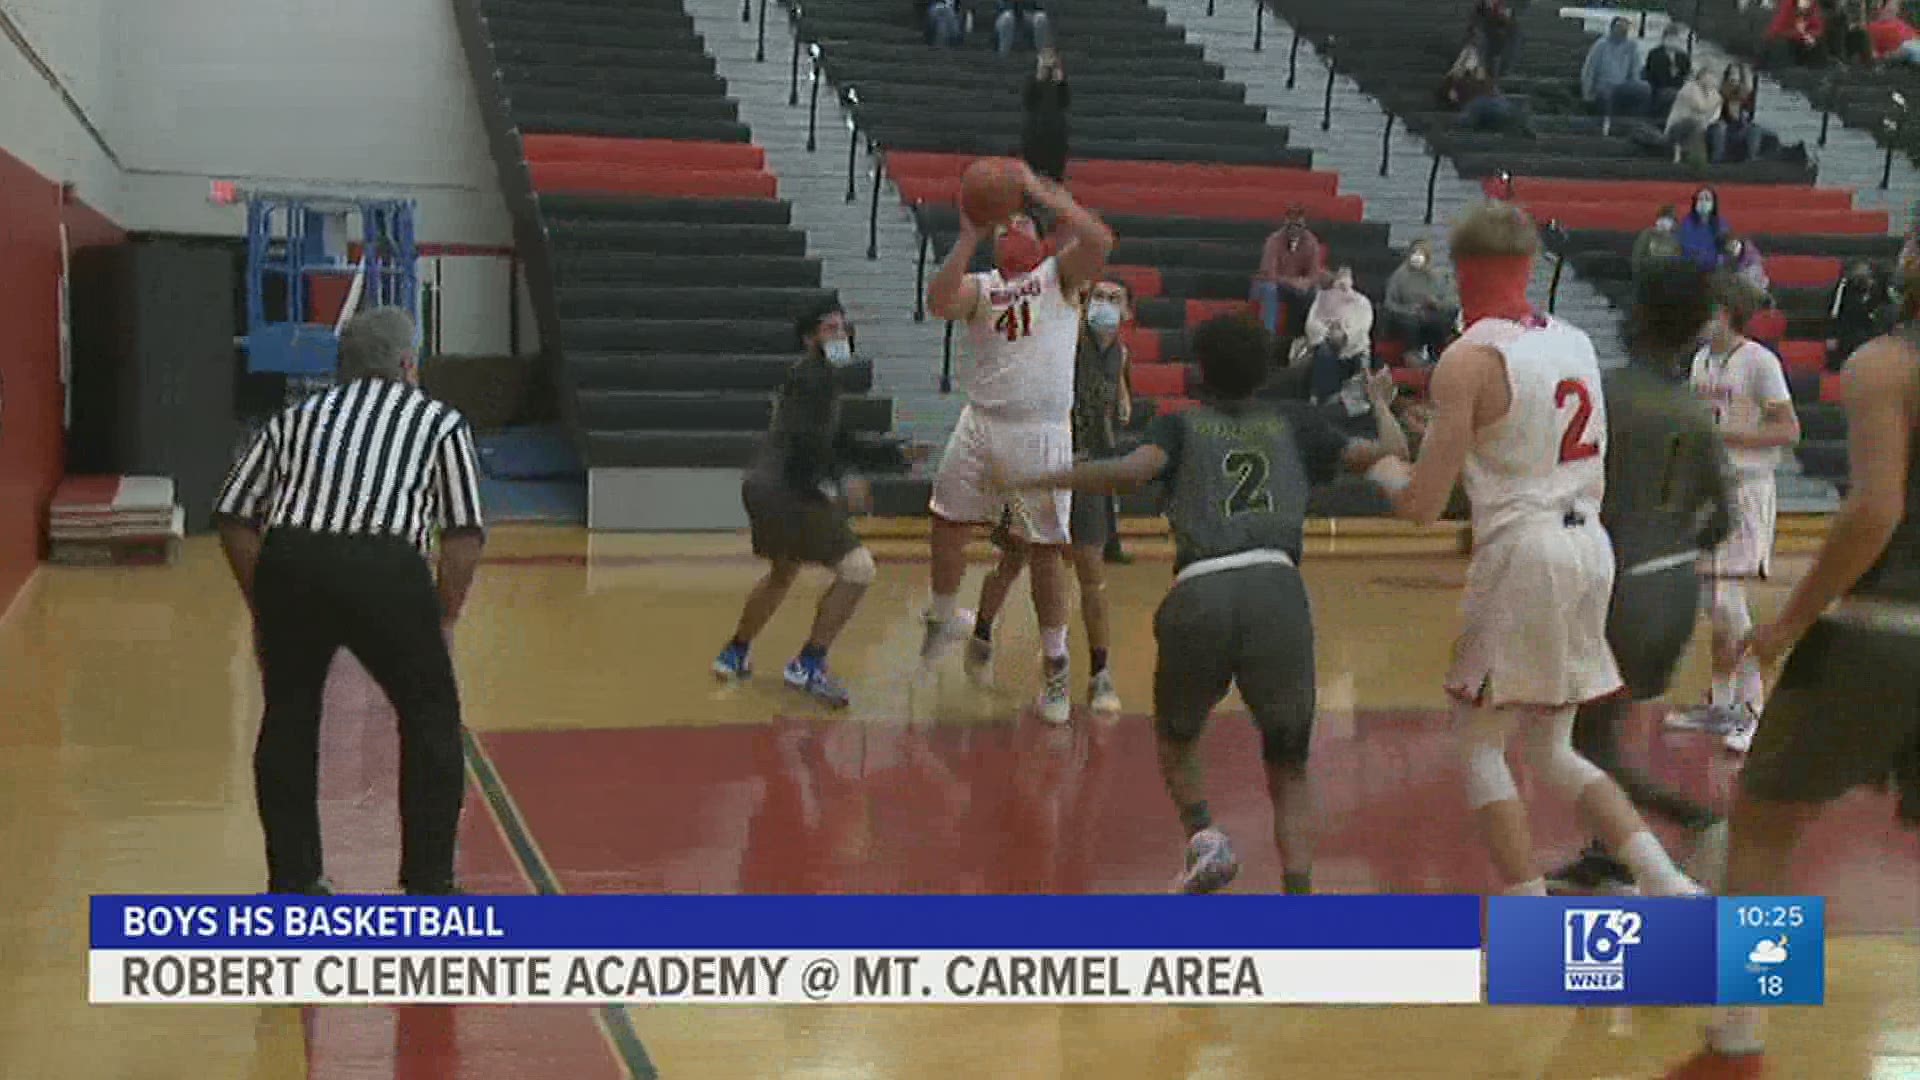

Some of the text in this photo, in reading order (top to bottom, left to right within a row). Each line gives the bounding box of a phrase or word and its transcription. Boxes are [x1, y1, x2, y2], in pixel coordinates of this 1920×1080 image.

[995, 299, 1030, 342] 41
[1555, 378, 1599, 464] 2
[1221, 448, 1274, 517] 2
